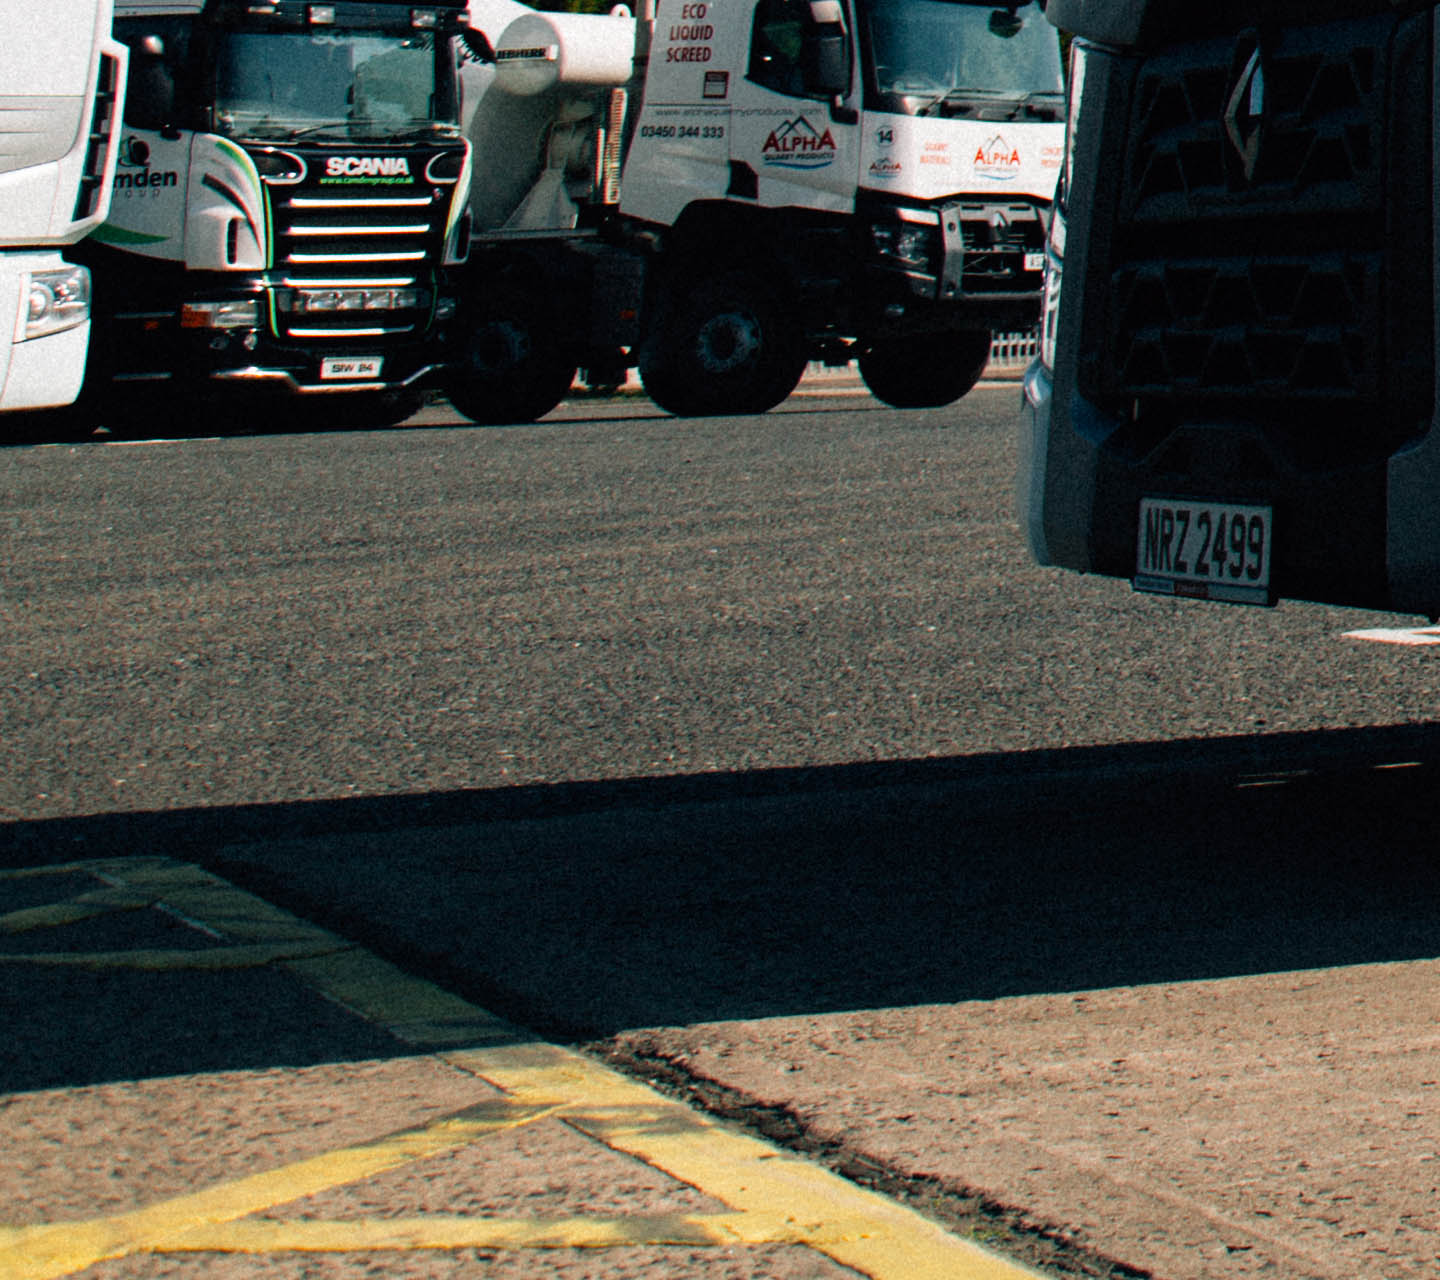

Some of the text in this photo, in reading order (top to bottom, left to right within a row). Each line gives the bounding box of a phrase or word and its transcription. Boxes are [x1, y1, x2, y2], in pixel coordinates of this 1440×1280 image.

[682, 3, 707, 19] ECO
[669, 25, 714, 41] LIQUID
[666, 46, 713, 63] SCREED
[641, 126, 725, 139] 03450 344 333
[878, 130, 894, 143] 14
[326, 156, 410, 176] SCANIA
[113, 167, 178, 188] mden
[1145, 508, 1264, 580] NRZ 2499
